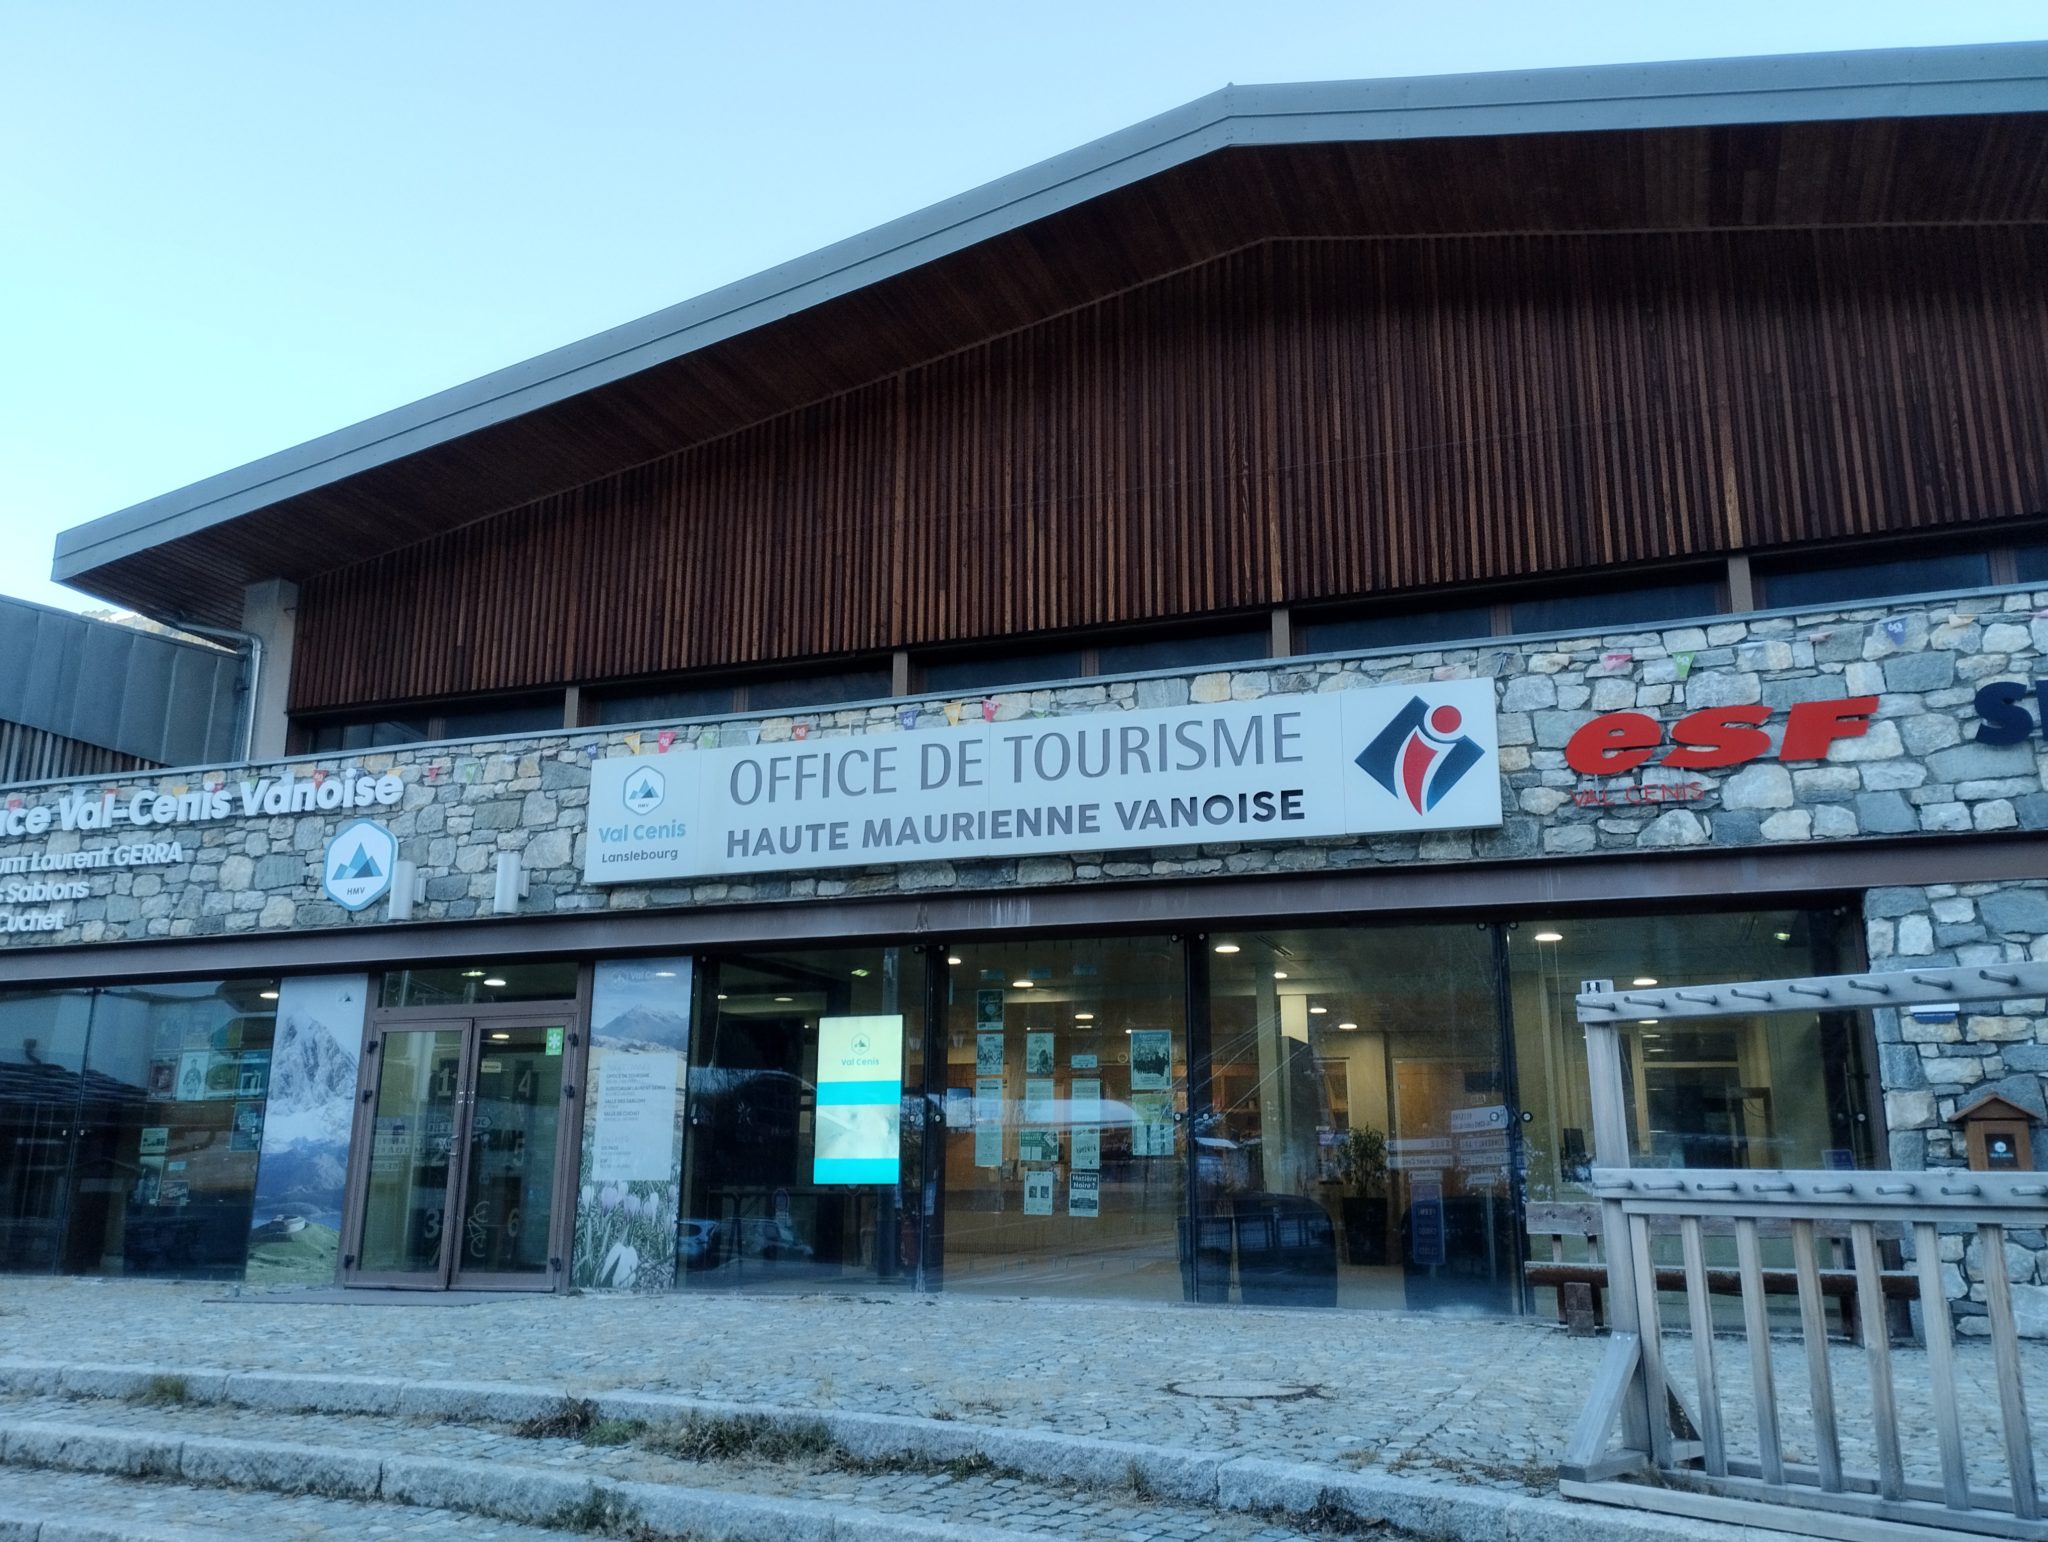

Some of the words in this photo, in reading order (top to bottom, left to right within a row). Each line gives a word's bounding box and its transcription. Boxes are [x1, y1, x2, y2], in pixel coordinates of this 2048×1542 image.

[1975, 680, 2048, 746] S
[730, 745, 898, 806] OFFICE
[920, 738, 983, 790] DE
[1003, 711, 1304, 784] TOURISME
[59, 781, 232, 831] Val-Cenis
[239, 768, 404, 817] Vanoise
[1625, 781, 1705, 805] CENIS
[598, 823, 628, 844] Val
[632, 818, 687, 841] Cenis
[726, 820, 849, 858] HAUTE
[862, 802, 1101, 849] MAURIENNE
[1114, 788, 1305, 831] VANOISE
[30, 846, 110, 872] Laurent
[113, 841, 183, 867] GERRA
[600, 845, 679, 864] Lanslebourg
[6, 880, 91, 904] Sablons
[345, 886, 367, 897] HMV
[0, 910, 66, 934] Cuchet
[841, 1057, 855, 1066] Val
[856, 1057, 880, 1067] Cenis
